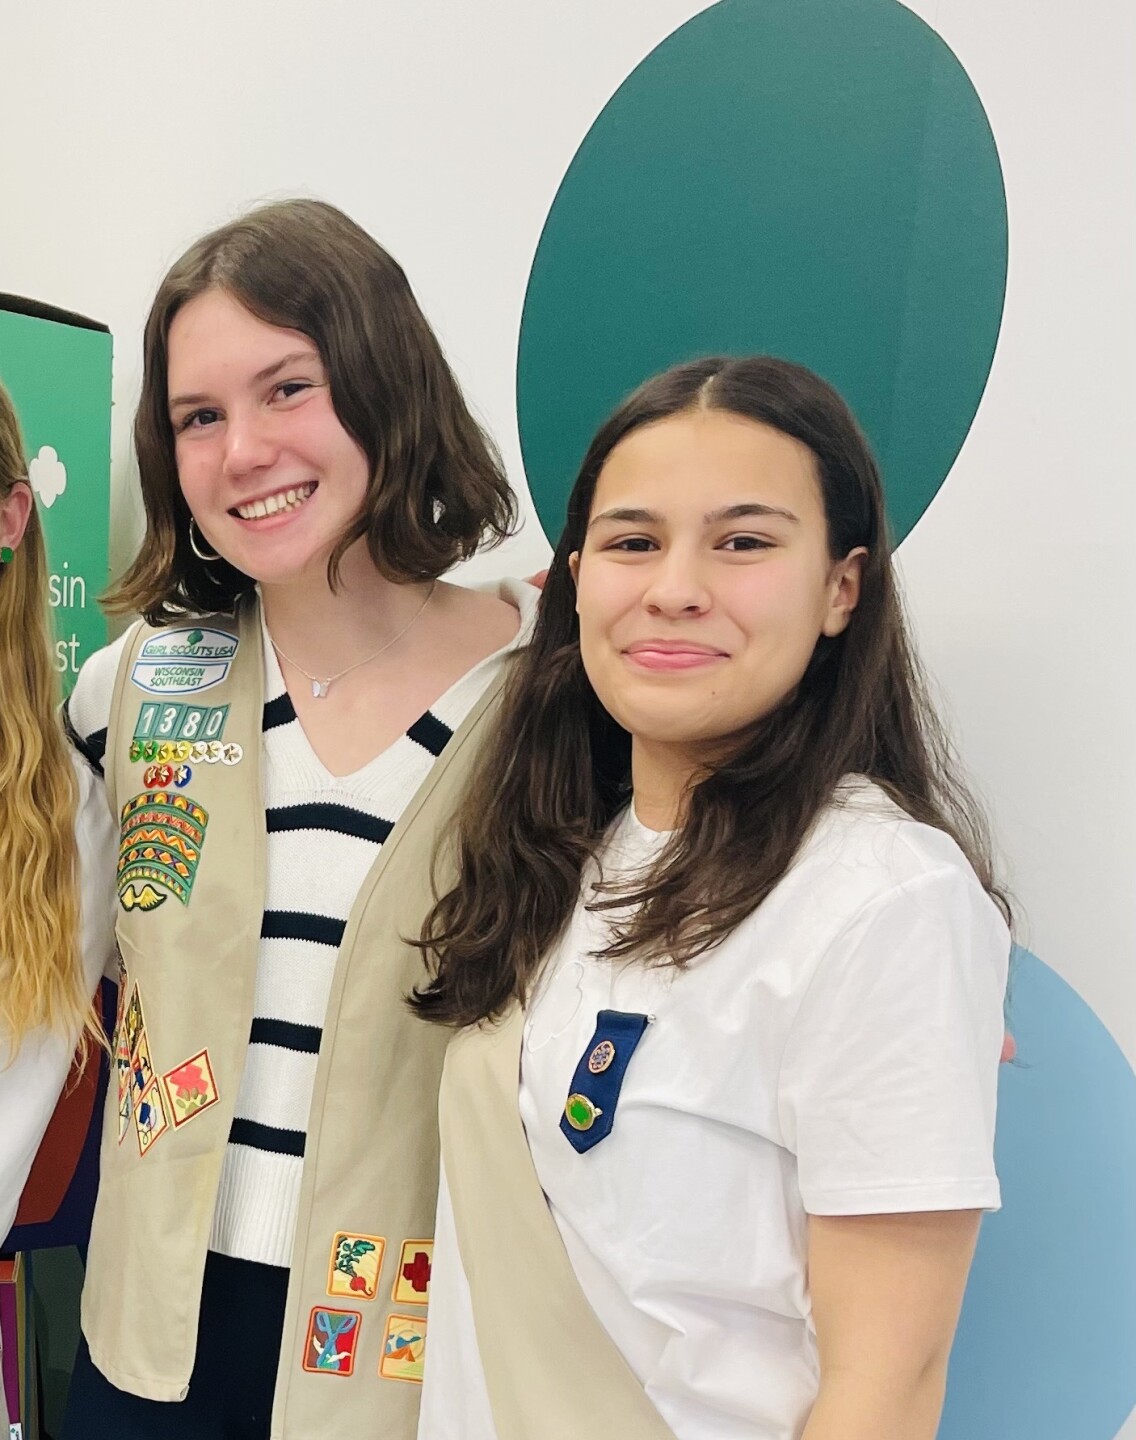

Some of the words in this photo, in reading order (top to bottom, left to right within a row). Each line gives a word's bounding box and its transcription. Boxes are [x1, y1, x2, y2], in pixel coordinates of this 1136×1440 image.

[146, 645, 167, 655] GIRL
[170, 645, 214, 656] SCOUTS
[214, 646, 234, 656] USA
[154, 666, 206, 677] WISCONSIN
[150, 676, 203, 687] SOUTHEAST
[142, 707, 224, 737] 1380
